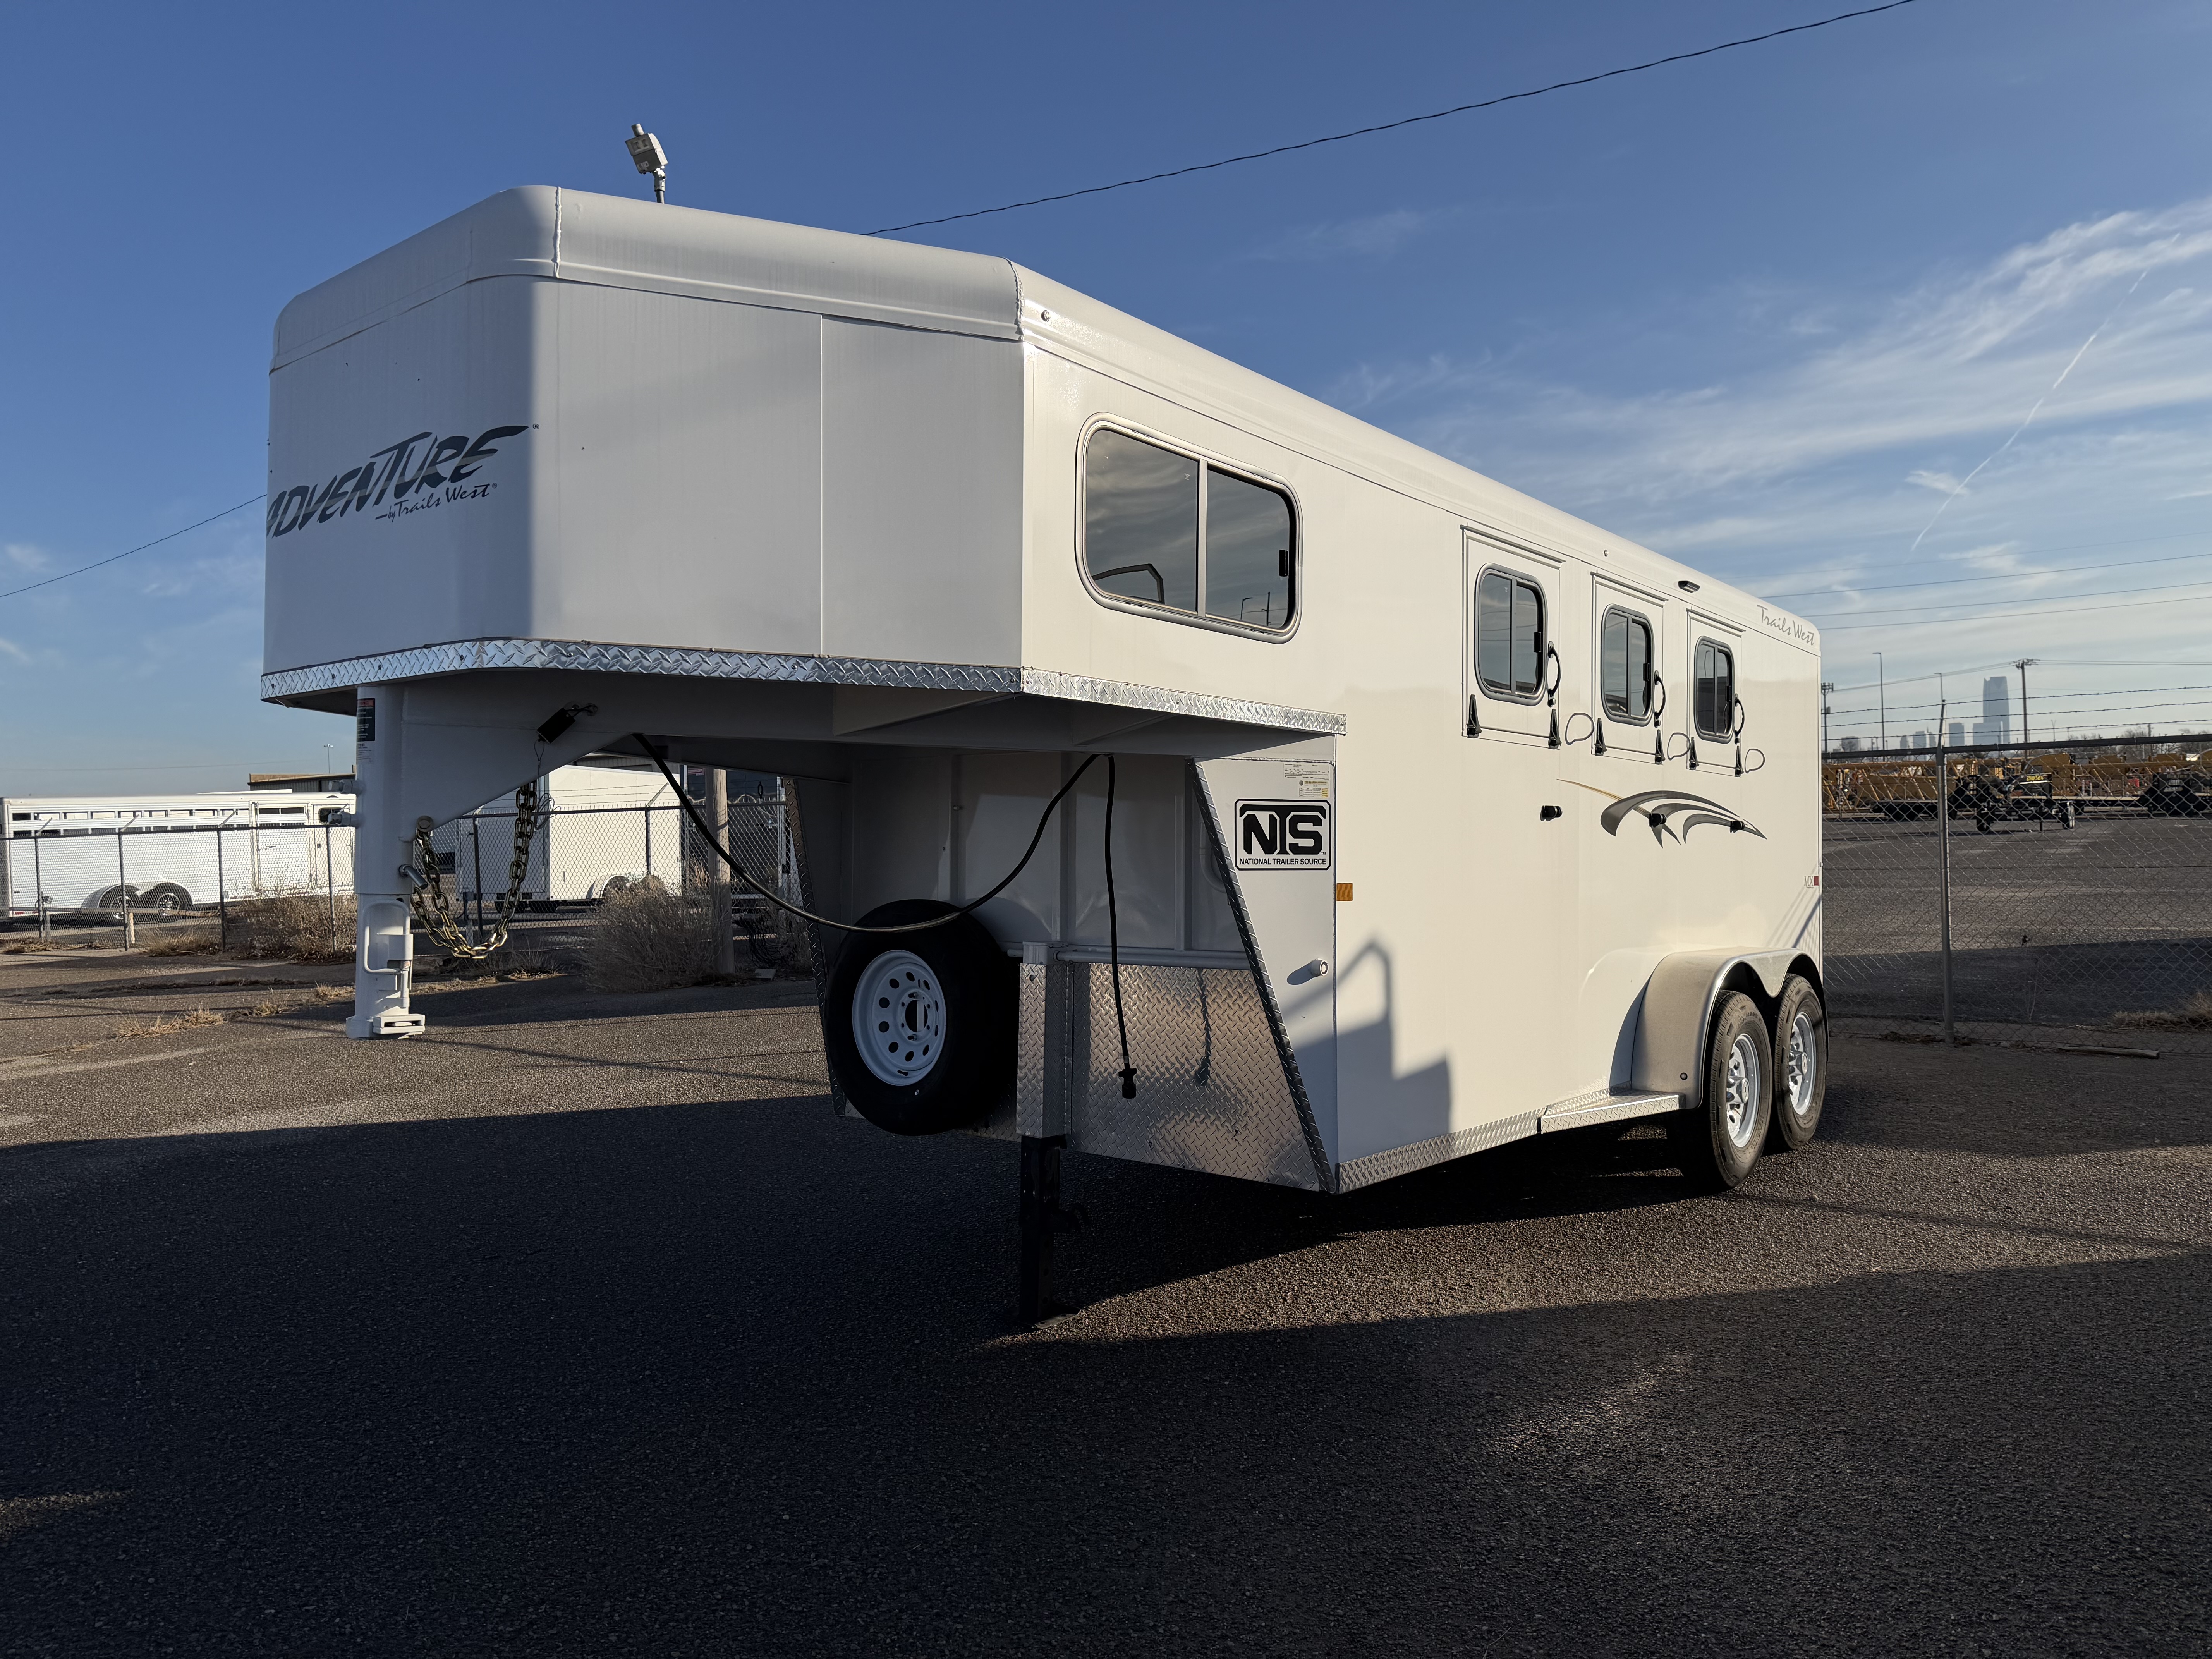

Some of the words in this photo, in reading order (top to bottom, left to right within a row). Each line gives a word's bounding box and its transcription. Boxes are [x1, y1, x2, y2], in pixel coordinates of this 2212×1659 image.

[266, 425, 529, 539] ADVENTURE
[394, 492, 441, 517] Trails
[445, 483, 490, 503] West
[1757, 604, 1791, 636] Trails
[1793, 620, 1815, 646] West
[1239, 804, 1326, 855] NTS
